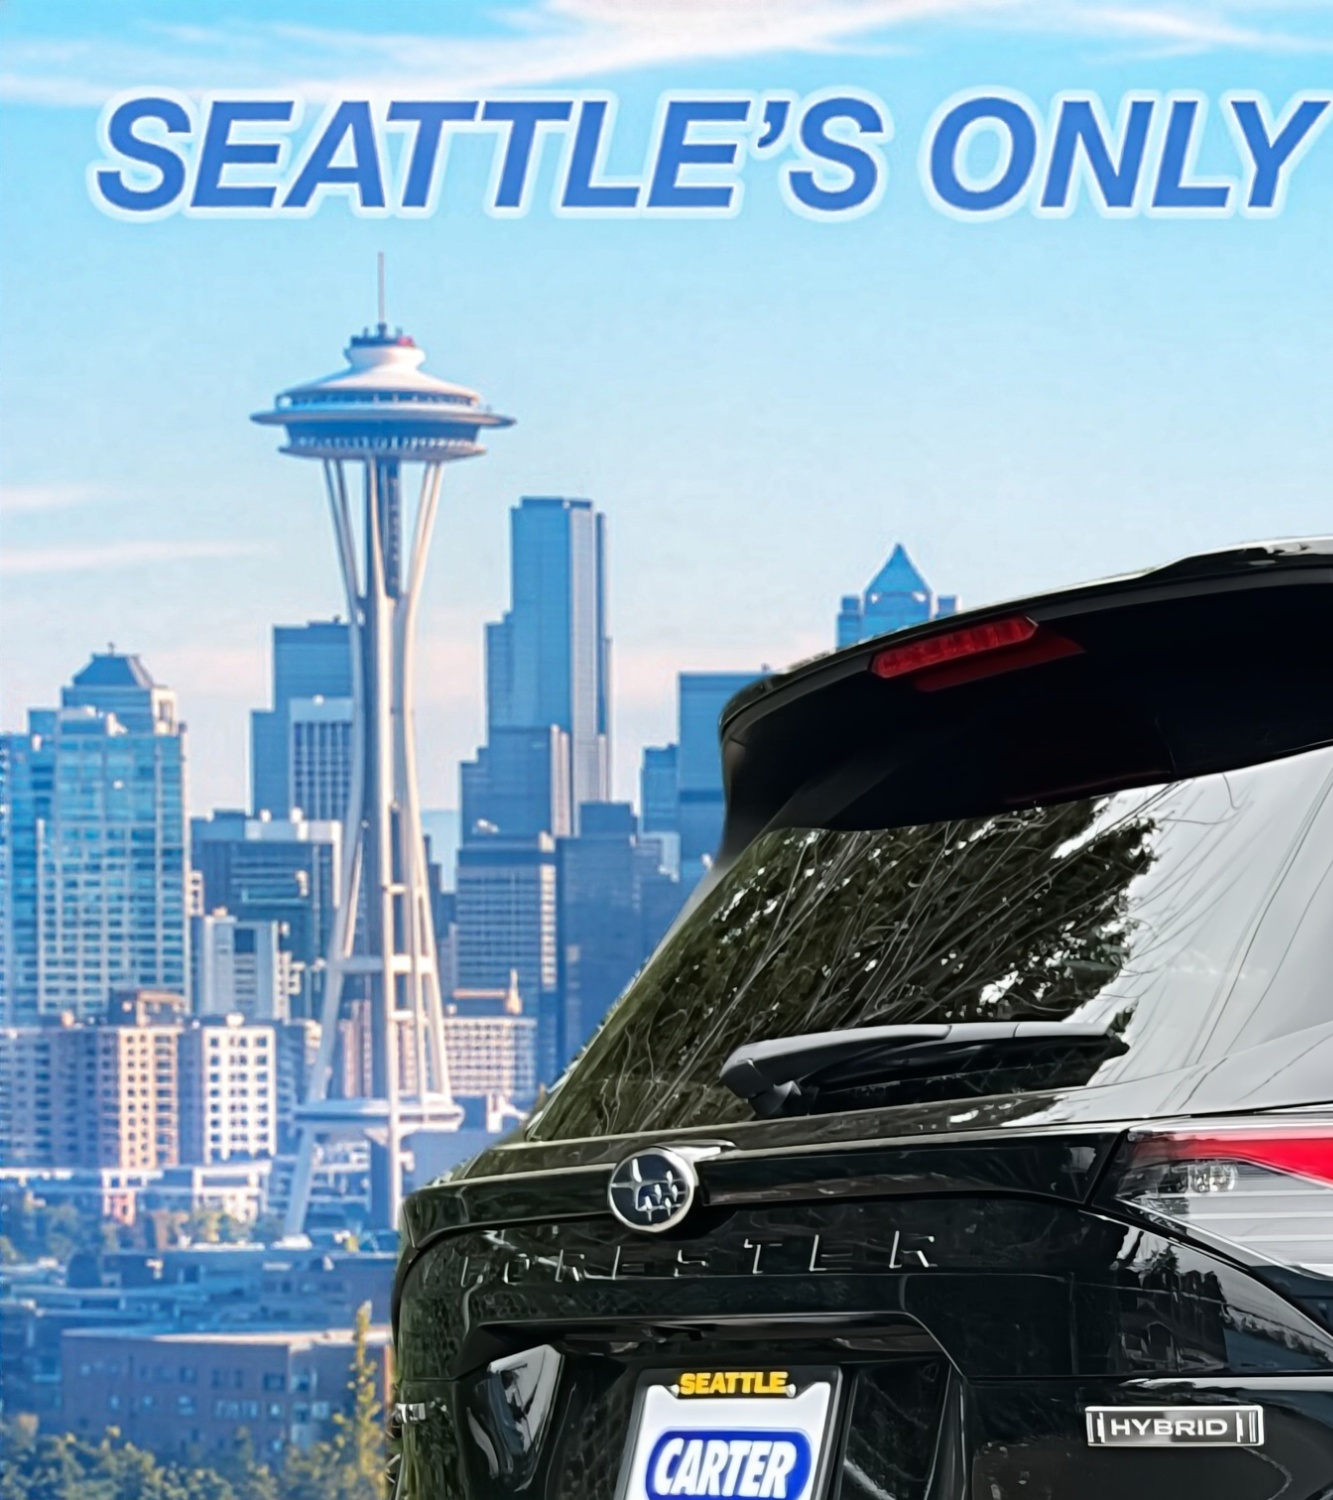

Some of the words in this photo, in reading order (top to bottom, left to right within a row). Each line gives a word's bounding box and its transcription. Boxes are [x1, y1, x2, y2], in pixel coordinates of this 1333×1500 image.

[678, 1371, 788, 1395] SEATTLE
[1110, 1418, 1228, 1436] HYBRID
[653, 1437, 798, 1499] CARTER
